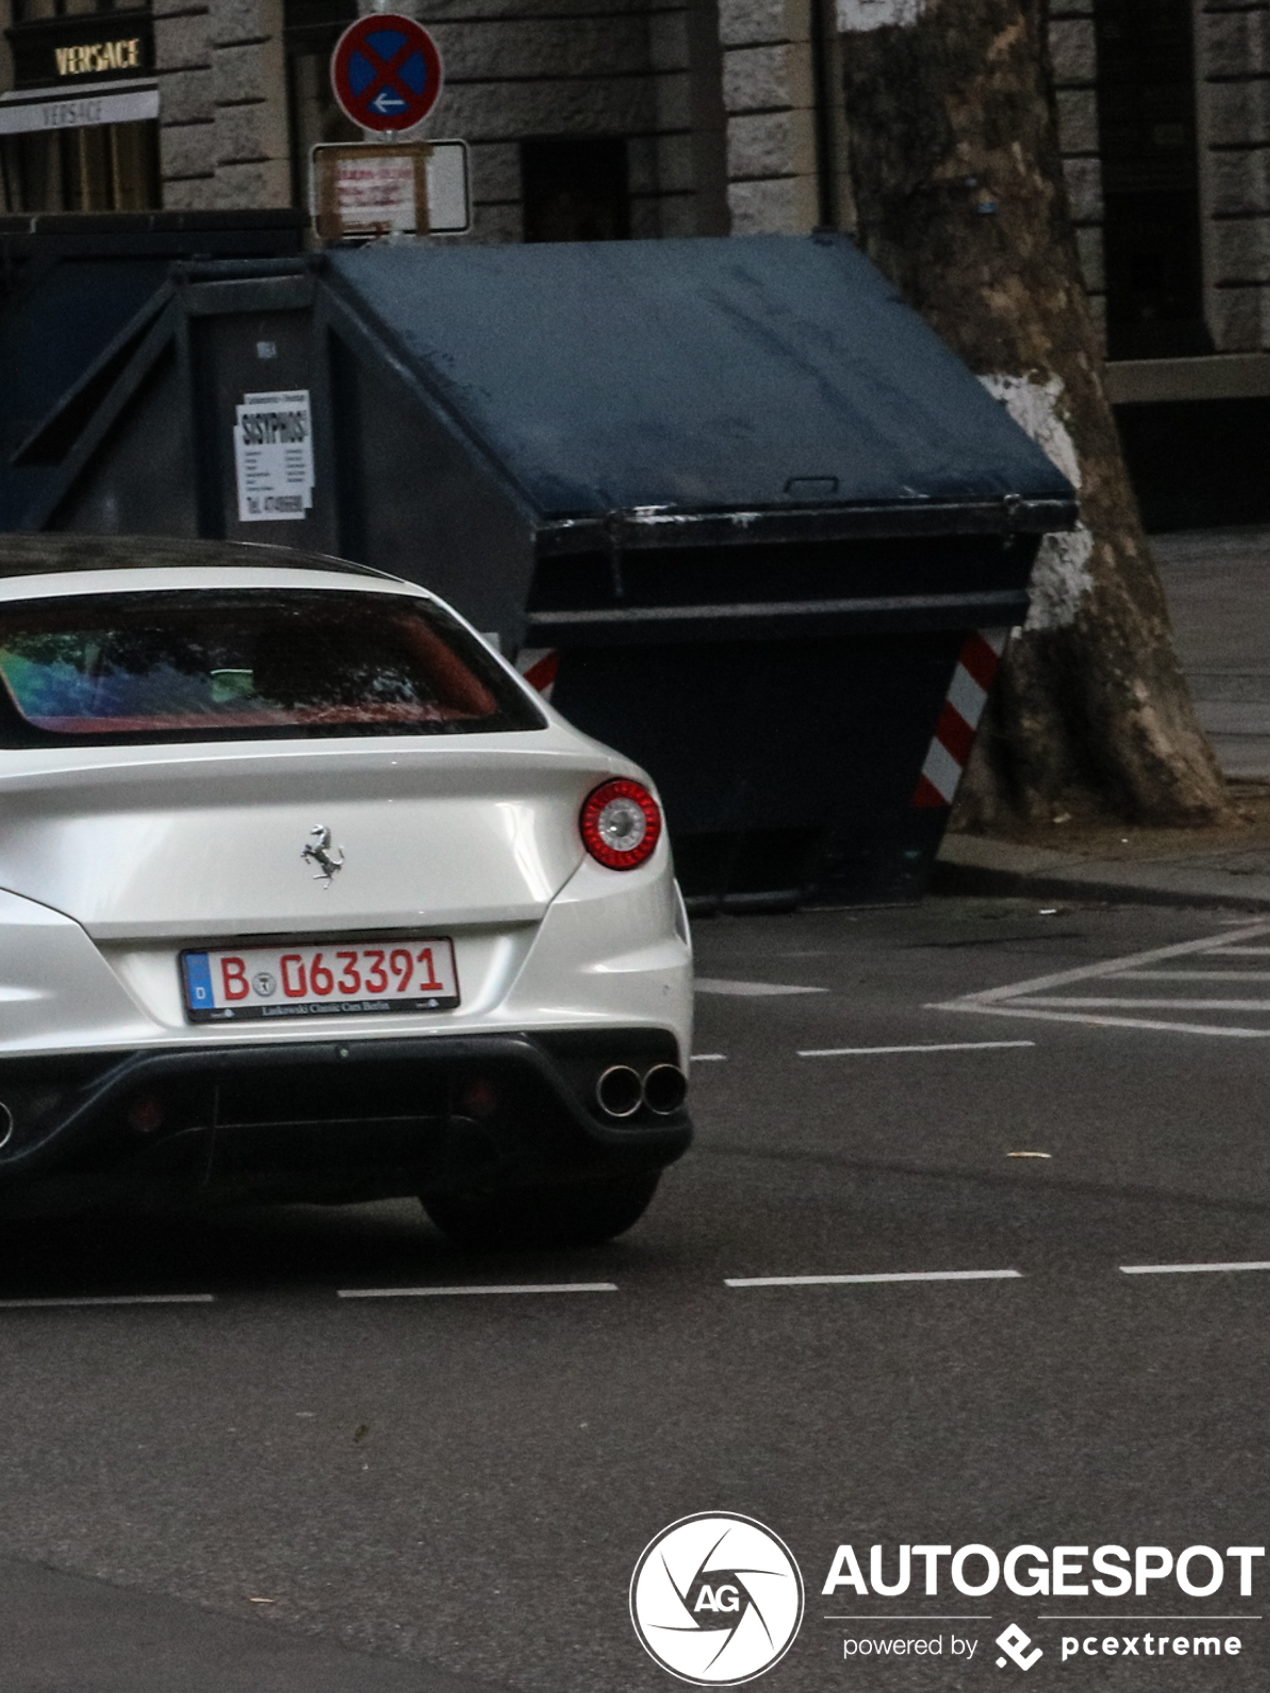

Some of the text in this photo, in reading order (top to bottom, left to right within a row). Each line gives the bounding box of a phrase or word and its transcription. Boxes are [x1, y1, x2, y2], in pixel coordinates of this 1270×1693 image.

[55, 38, 140, 76] VERSACE
[42, 101, 103, 126] VERSACE
[242, 411, 304, 445] SISYPHOS
[221, 947, 443, 1001] B 063391
[196, 987, 206, 999] D
[341, 1001, 362, 1012] Cars
[362, 1000, 391, 1011] Berlin
